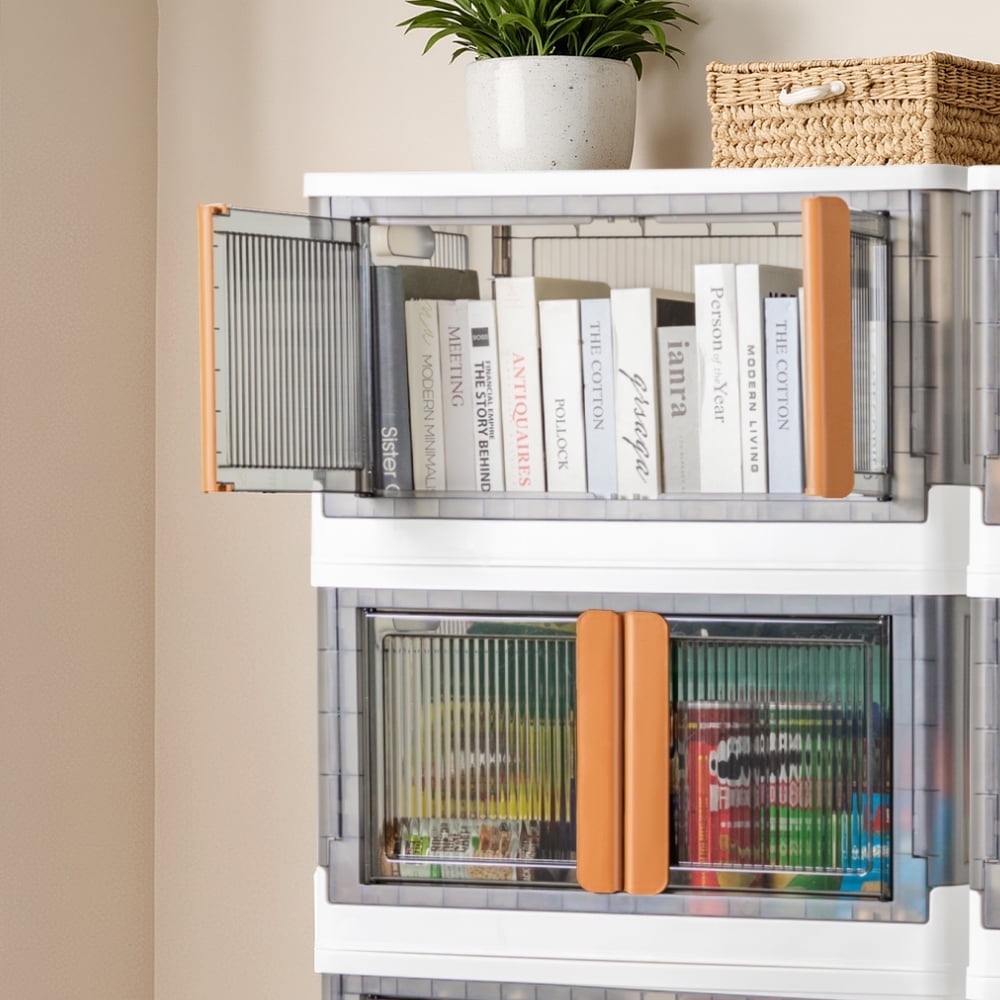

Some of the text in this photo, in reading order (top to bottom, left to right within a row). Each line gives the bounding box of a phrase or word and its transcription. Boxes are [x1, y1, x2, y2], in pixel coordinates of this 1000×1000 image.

[709, 287, 725, 351] Person
[421, 354, 435, 421] MODERN
[448, 326, 465, 408] MEETING
[589, 321, 605, 431] THE COTTON
[711, 382, 727, 423] Year
[774, 320, 789, 431] THE COTTON
[474, 361, 492, 492] THE STORY BEHIND
[488, 408, 496, 440] EMPIRE
[511, 352, 532, 487] ANTIQUAIRES
[555, 398, 569, 471] POLLOCK
[745, 344, 760, 474] MODERN LIVING
[381, 427, 400, 478] Sister
